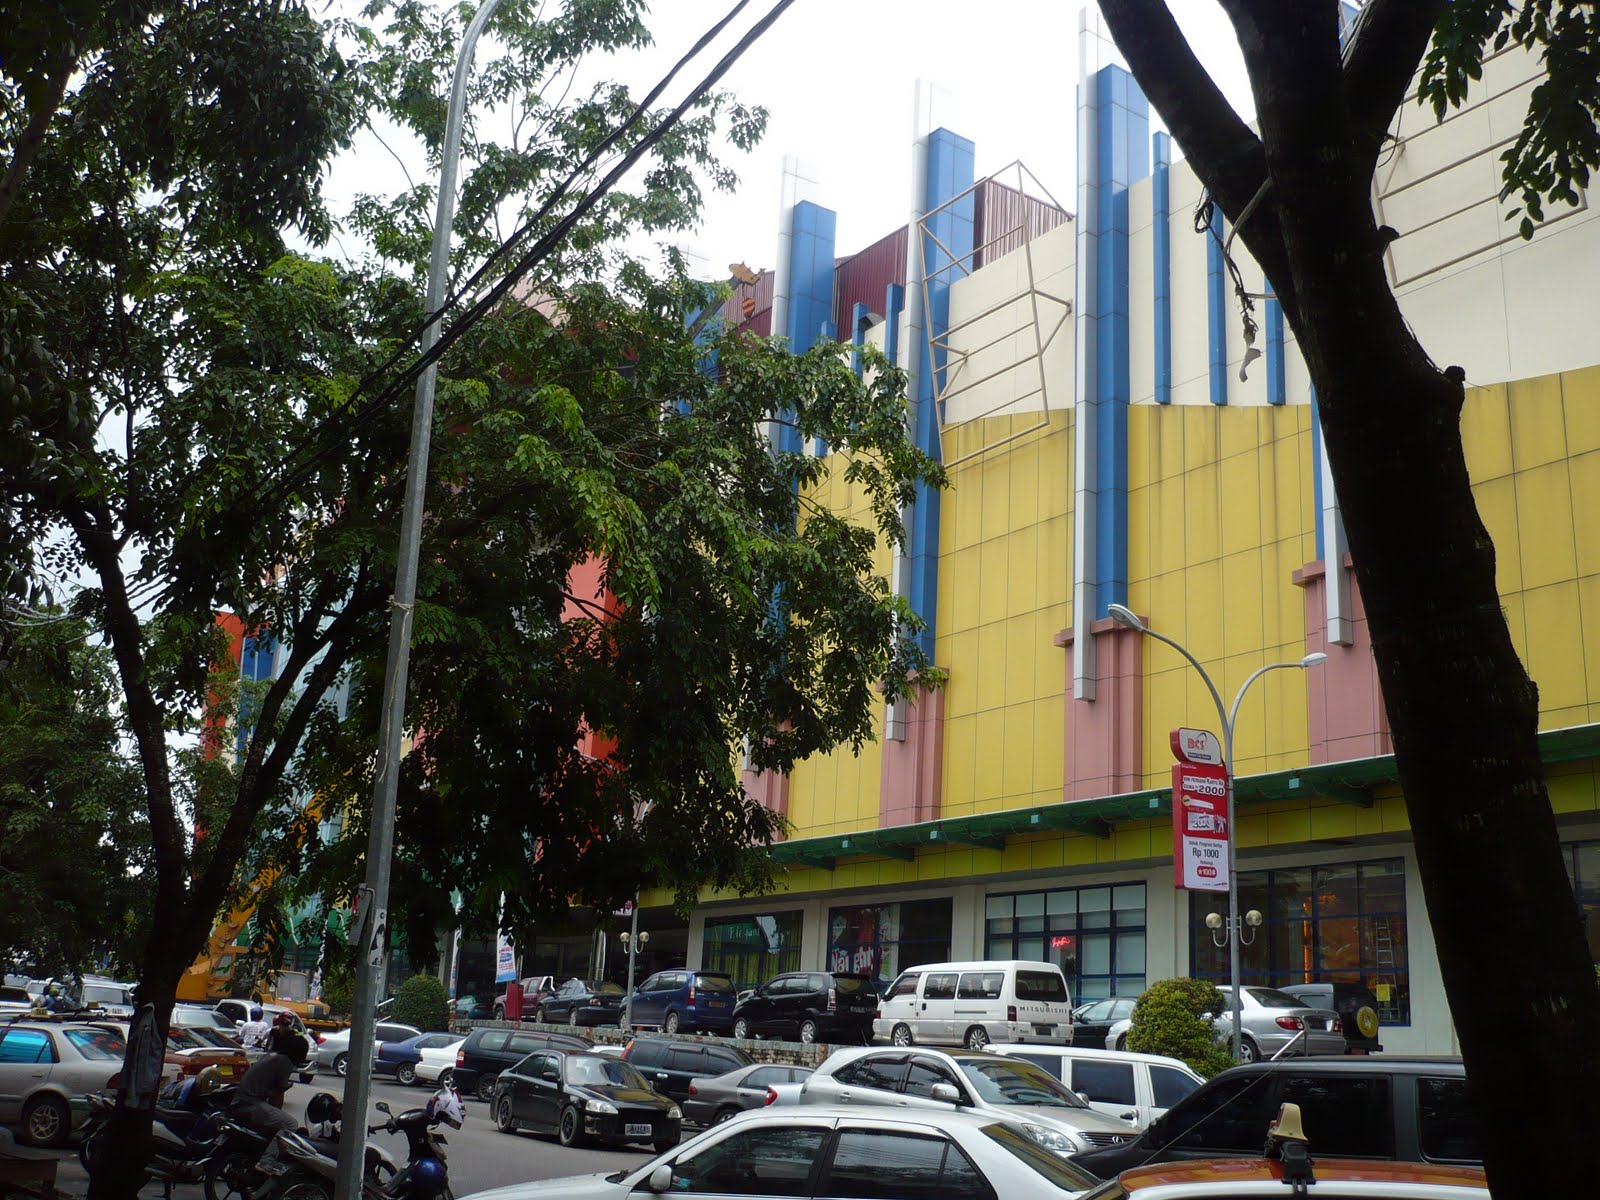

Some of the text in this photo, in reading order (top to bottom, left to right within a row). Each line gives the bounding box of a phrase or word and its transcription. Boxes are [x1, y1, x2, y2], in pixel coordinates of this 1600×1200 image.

[1199, 785, 1225, 796] 2000
[1192, 847, 1220, 858] Rp 1000
[1019, 1006, 1068, 1014] MITSUBISHI
